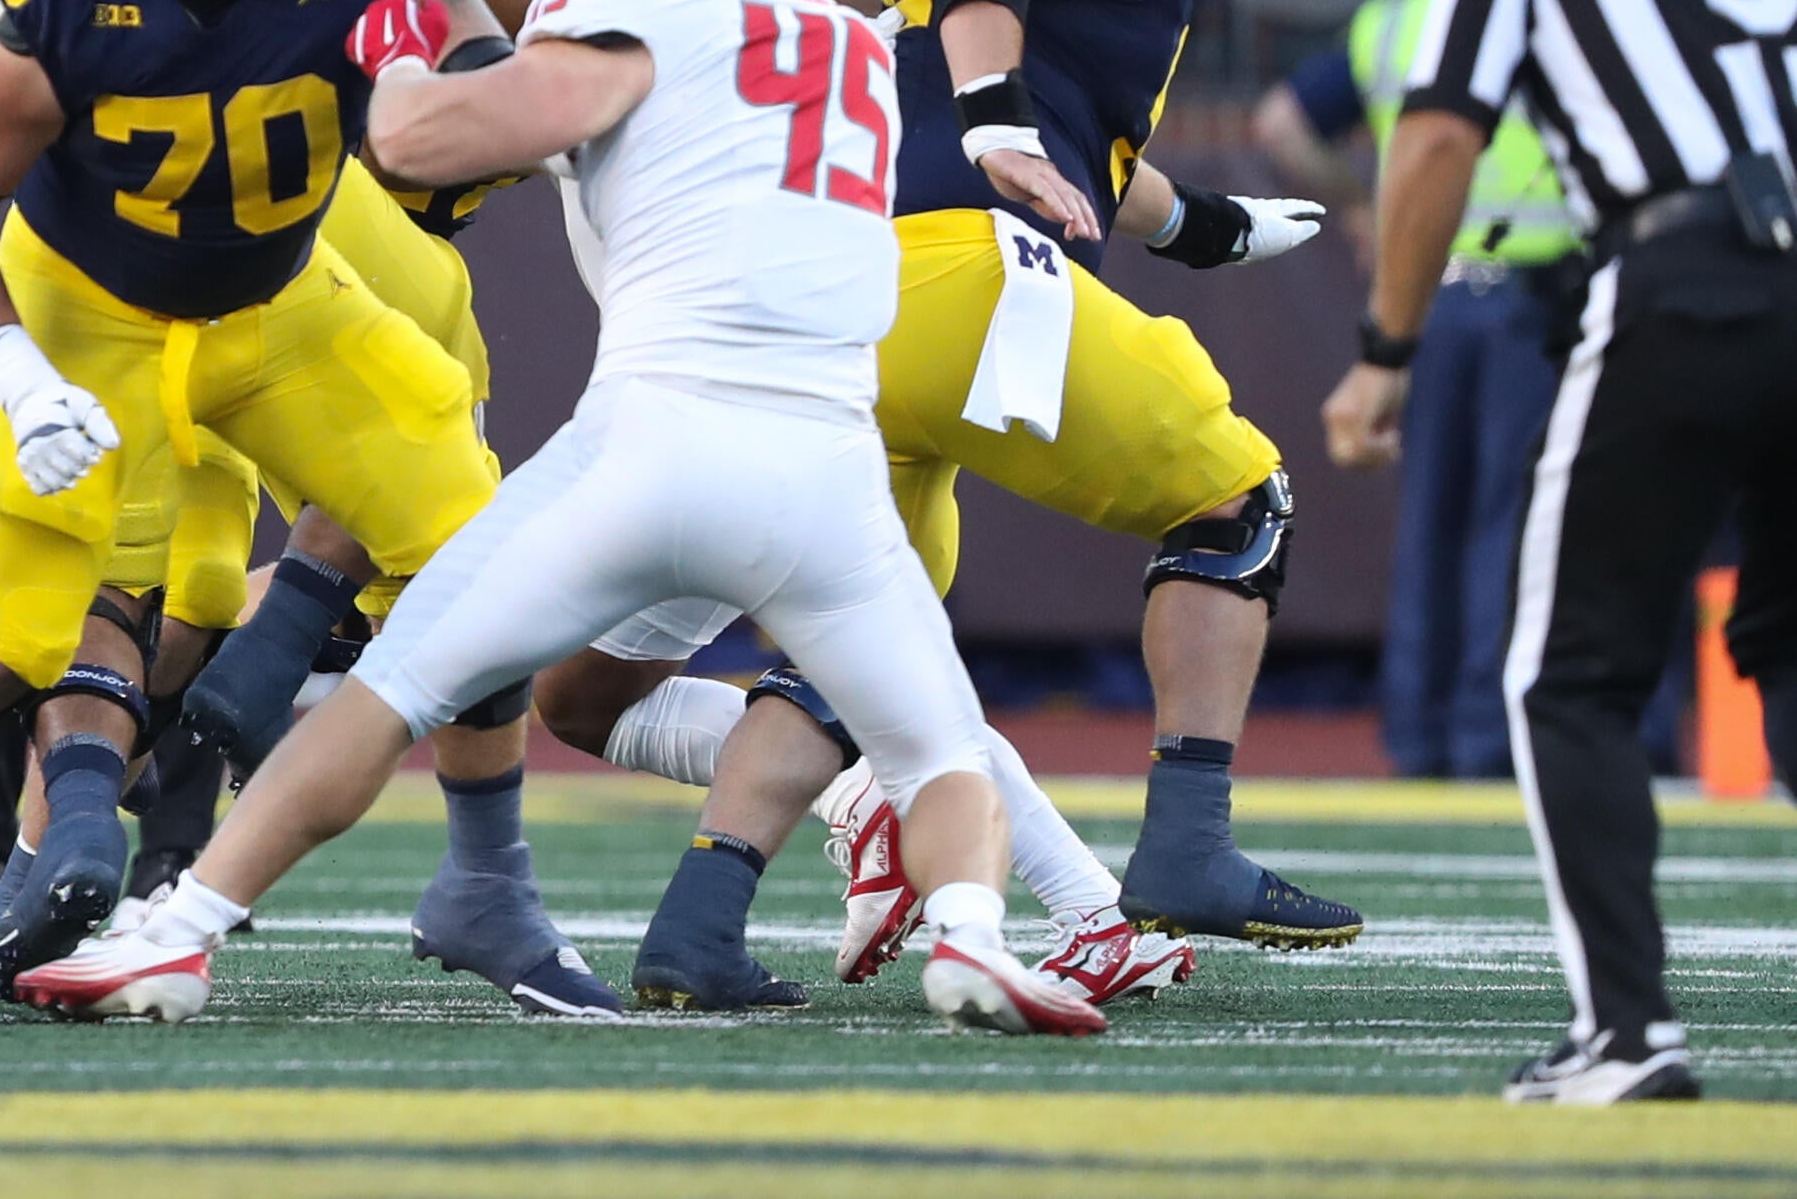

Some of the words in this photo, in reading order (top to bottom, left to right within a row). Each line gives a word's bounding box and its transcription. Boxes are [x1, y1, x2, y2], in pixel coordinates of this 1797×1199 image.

[92, 72, 344, 239] 70
[1012, 234, 1059, 277] M
[63, 670, 135, 687] DONJOY
[876, 820, 890, 874] ALPHA
